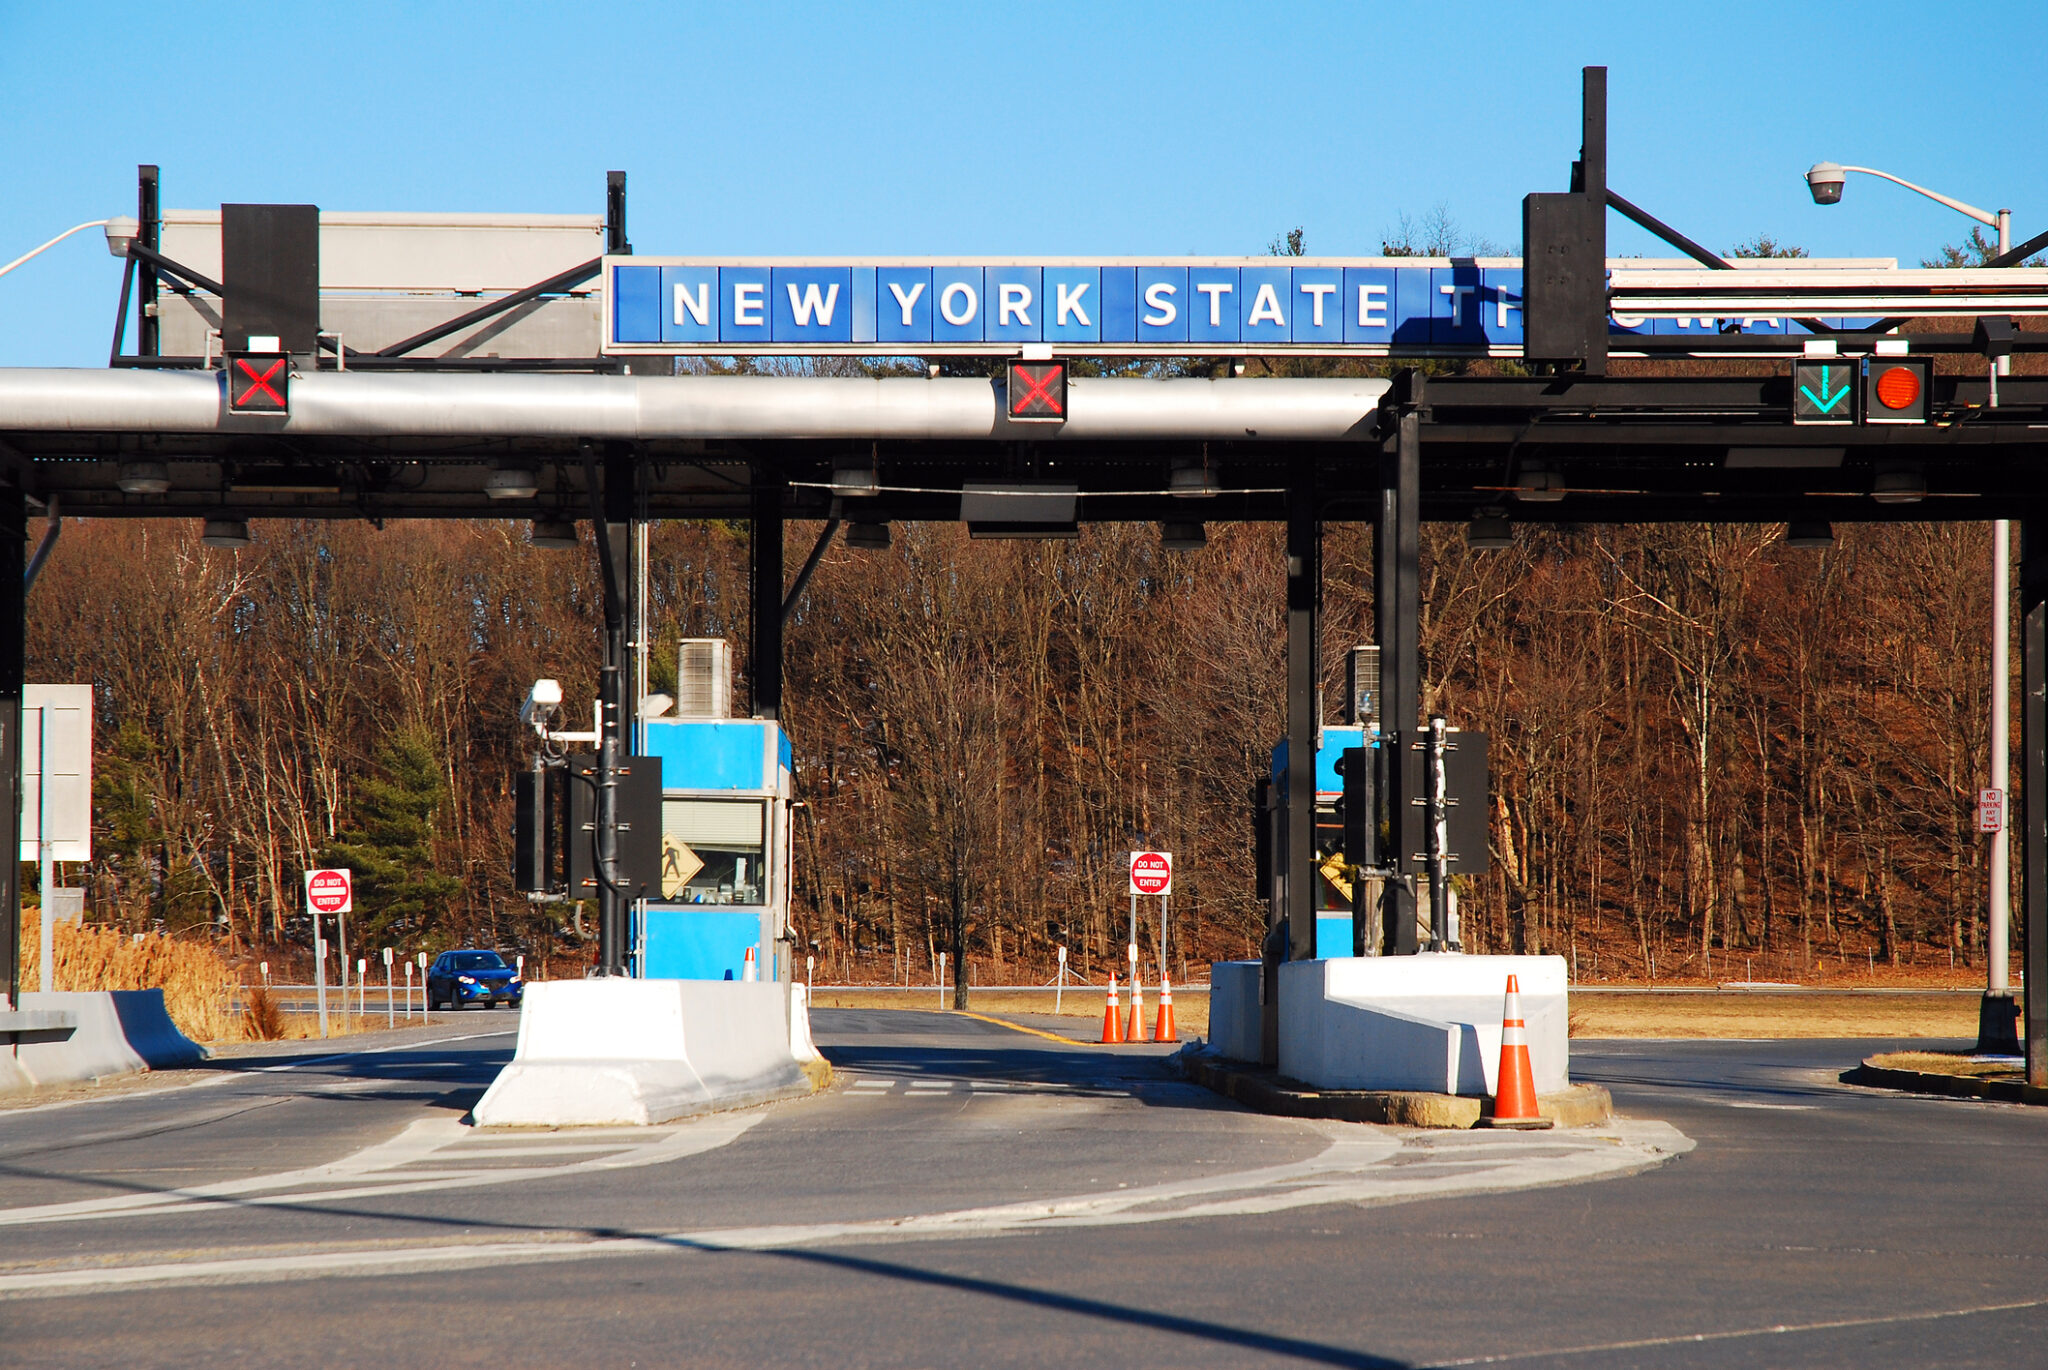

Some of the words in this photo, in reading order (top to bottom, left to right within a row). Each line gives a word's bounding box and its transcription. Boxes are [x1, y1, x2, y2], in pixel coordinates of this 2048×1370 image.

[673, 282, 840, 326] NEW
[888, 282, 1092, 326] YORK
[1142, 282, 1388, 327] STATE
[1986, 791, 1996, 801] NO
[1138, 860, 1148, 869] DO
[1150, 861, 1164, 869] NOT
[314, 879, 325, 887] DO
[327, 878, 342, 886] NOT
[1139, 879, 1162, 887] ENTER
[317, 897, 341, 906] ENTER
